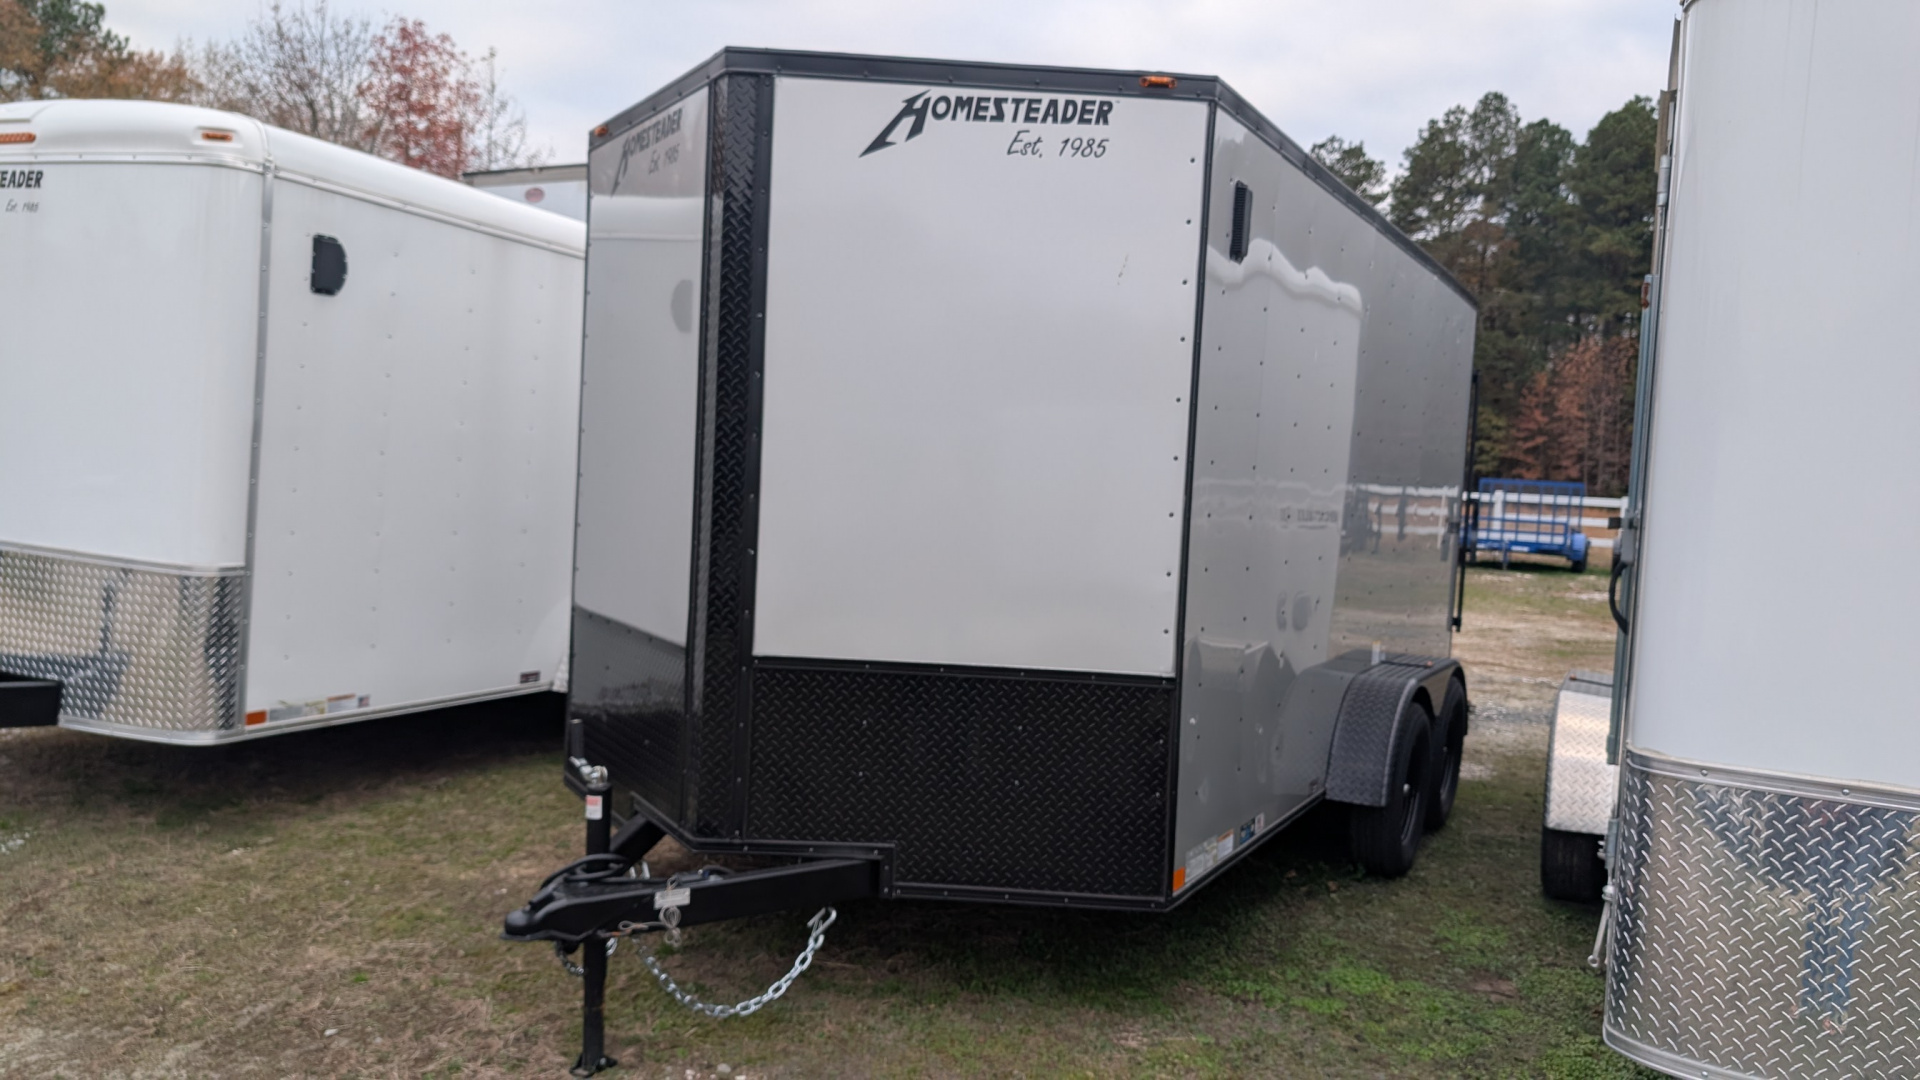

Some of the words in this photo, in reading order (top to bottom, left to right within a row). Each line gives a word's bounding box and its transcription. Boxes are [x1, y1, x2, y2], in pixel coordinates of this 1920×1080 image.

[858, 89, 1114, 158] HOMESTEADER
[1006, 130, 1043, 158] Est.
[1058, 138, 1110, 158] 1985
